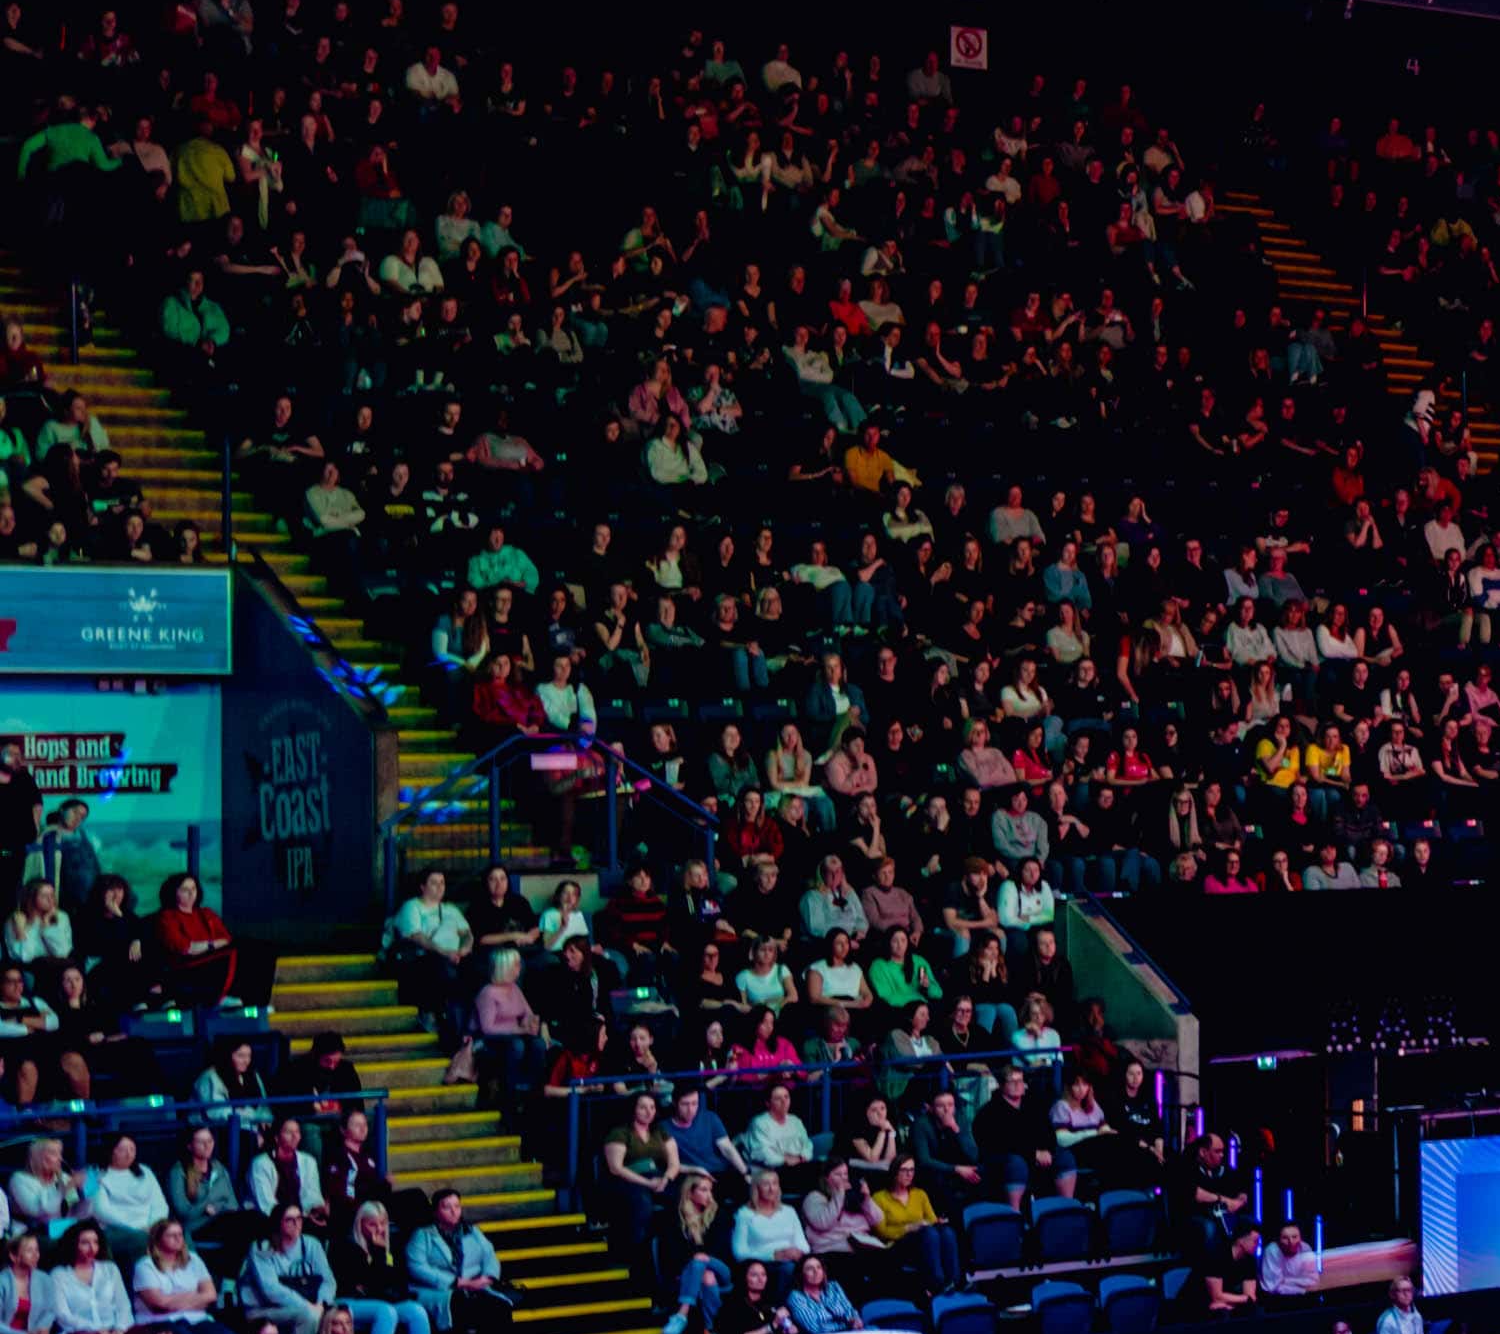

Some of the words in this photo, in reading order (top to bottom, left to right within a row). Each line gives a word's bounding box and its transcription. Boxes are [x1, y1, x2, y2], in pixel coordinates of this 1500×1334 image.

[81, 627, 154, 643] GREENE
[159, 627, 205, 644] KING
[24, 733, 70, 763] Hops
[75, 735, 112, 759] and
[271, 730, 321, 786] EAST
[76, 765, 162, 793] Brewing
[259, 773, 331, 843] Coast
[287, 845, 315, 892] IPA
